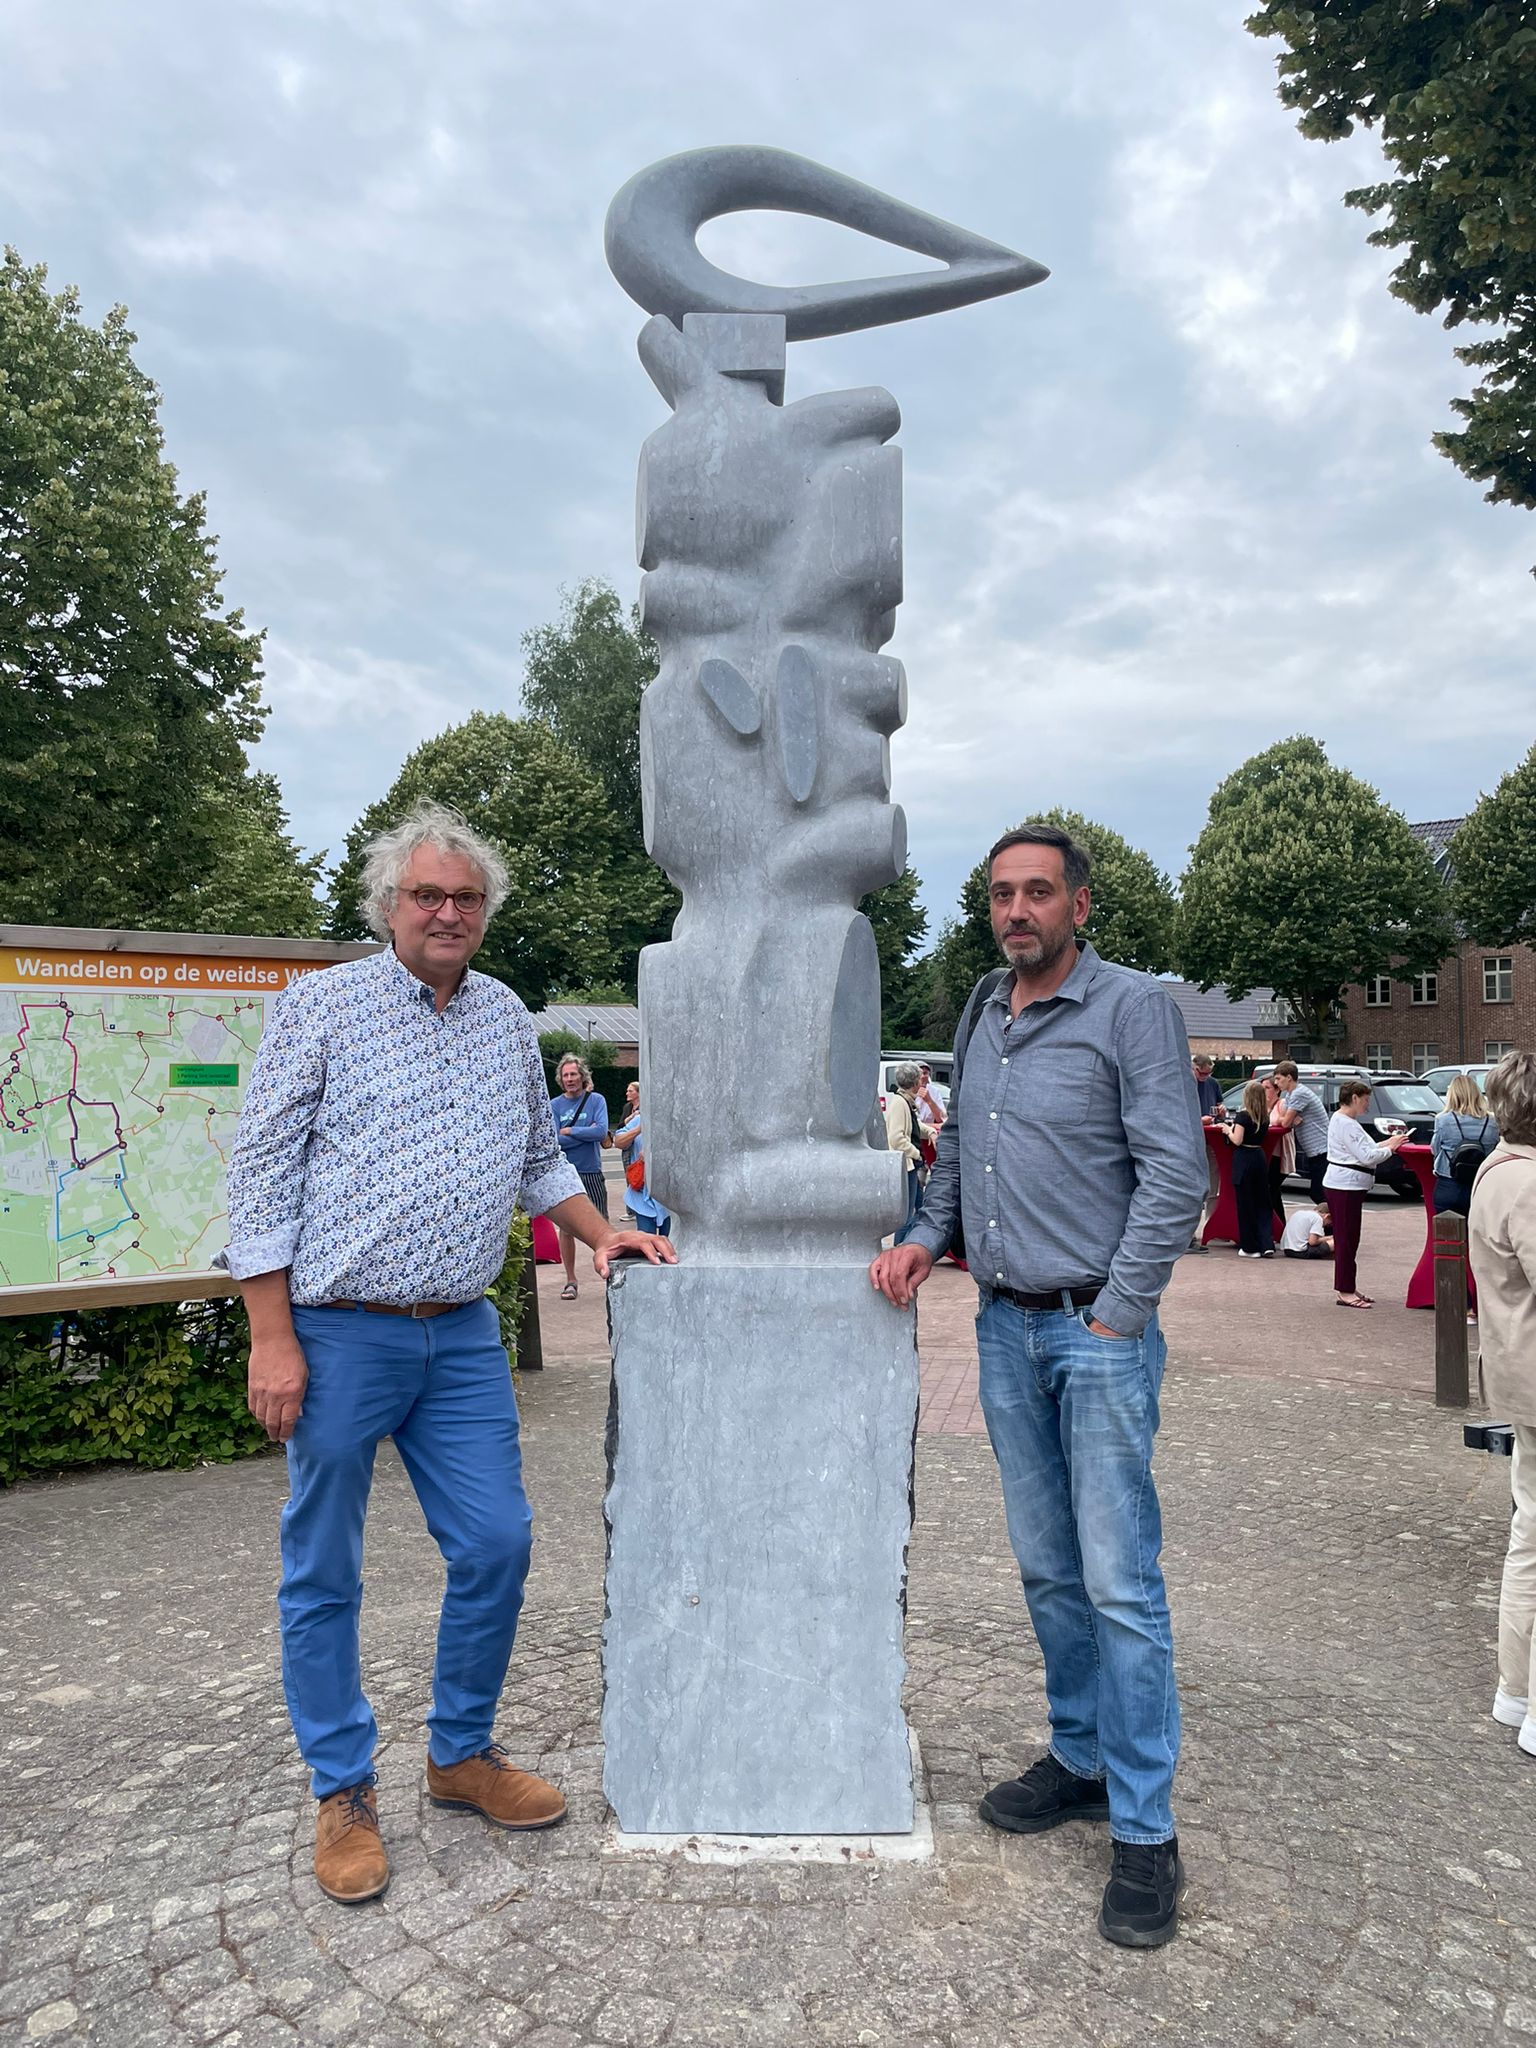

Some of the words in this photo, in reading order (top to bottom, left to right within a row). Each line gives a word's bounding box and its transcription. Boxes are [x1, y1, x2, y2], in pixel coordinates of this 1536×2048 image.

[15, 957, 133, 980] Wandelen
[139, 965, 168, 984] op
[174, 963, 200, 982] de
[206, 965, 279, 984] weidse
